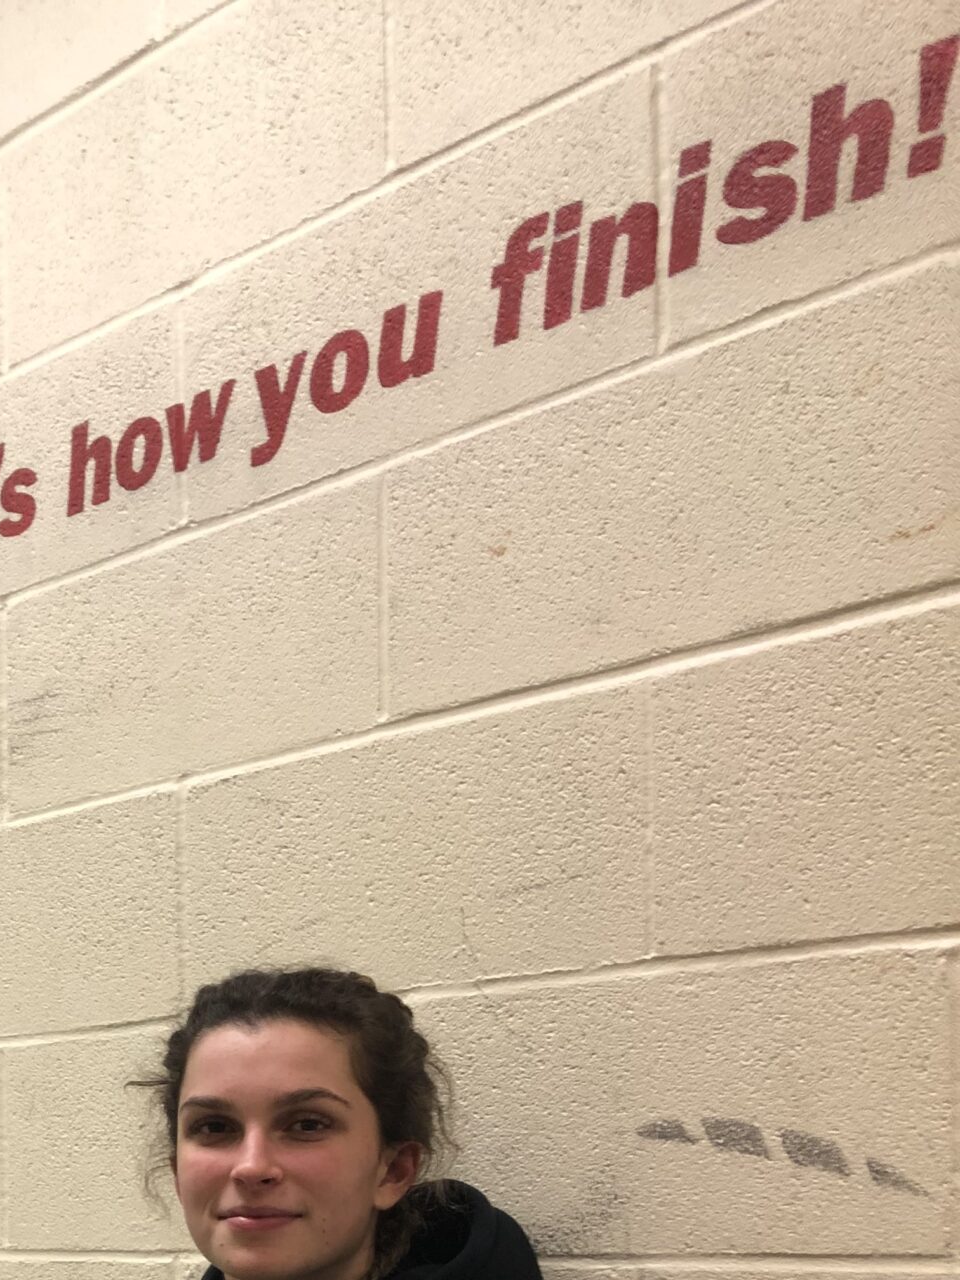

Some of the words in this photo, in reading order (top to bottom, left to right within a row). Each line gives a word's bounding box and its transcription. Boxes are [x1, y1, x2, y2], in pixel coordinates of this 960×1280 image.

[66, 378, 237, 518] how
[250, 290, 443, 468] you
[490, 33, 960, 347] finish!
